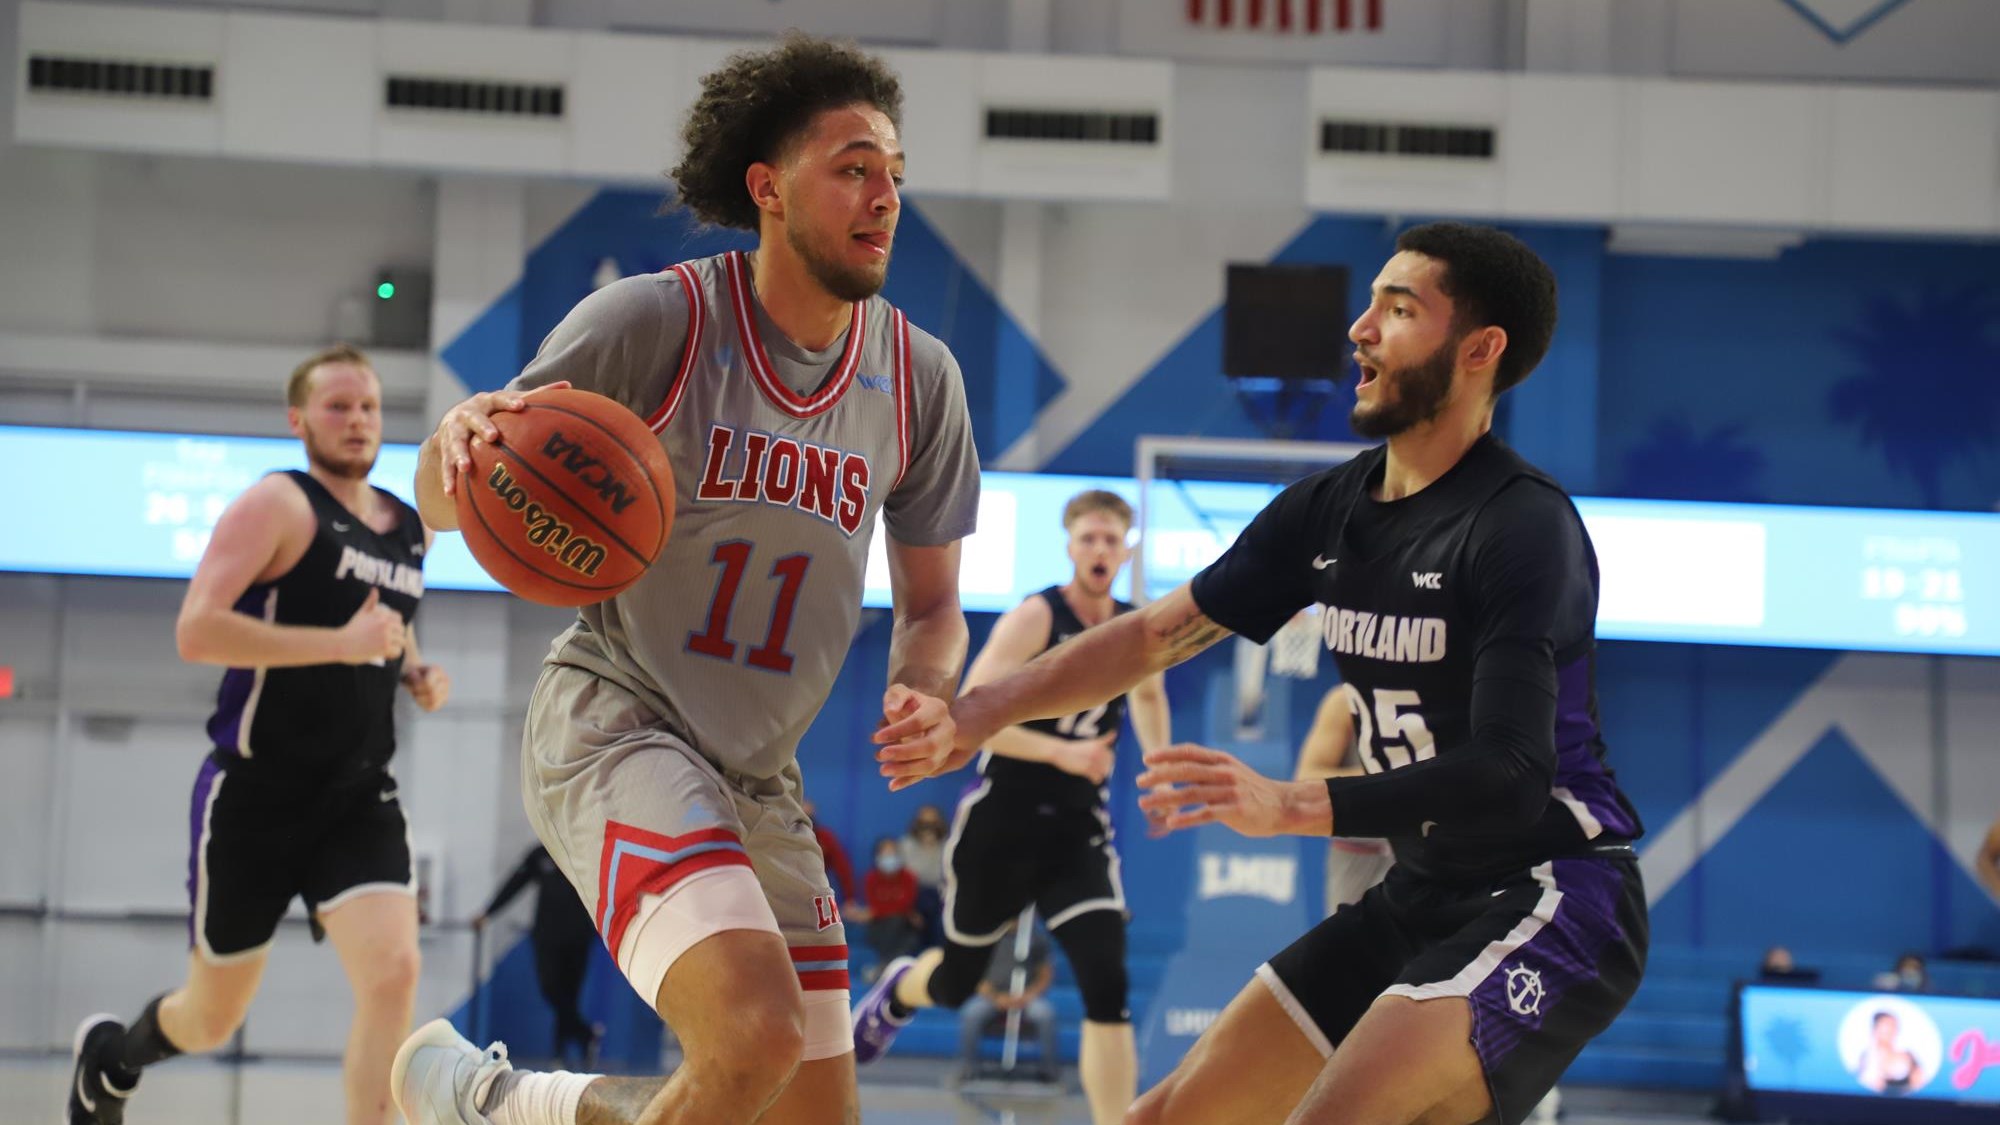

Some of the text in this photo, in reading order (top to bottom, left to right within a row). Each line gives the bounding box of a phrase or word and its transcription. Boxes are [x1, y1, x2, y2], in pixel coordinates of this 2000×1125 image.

[488, 462, 607, 577] Wilson
[543, 432, 638, 514] NCAA
[696, 423, 871, 537] LIONS
[685, 538, 813, 676] 11
[1411, 571, 1442, 589] WCC
